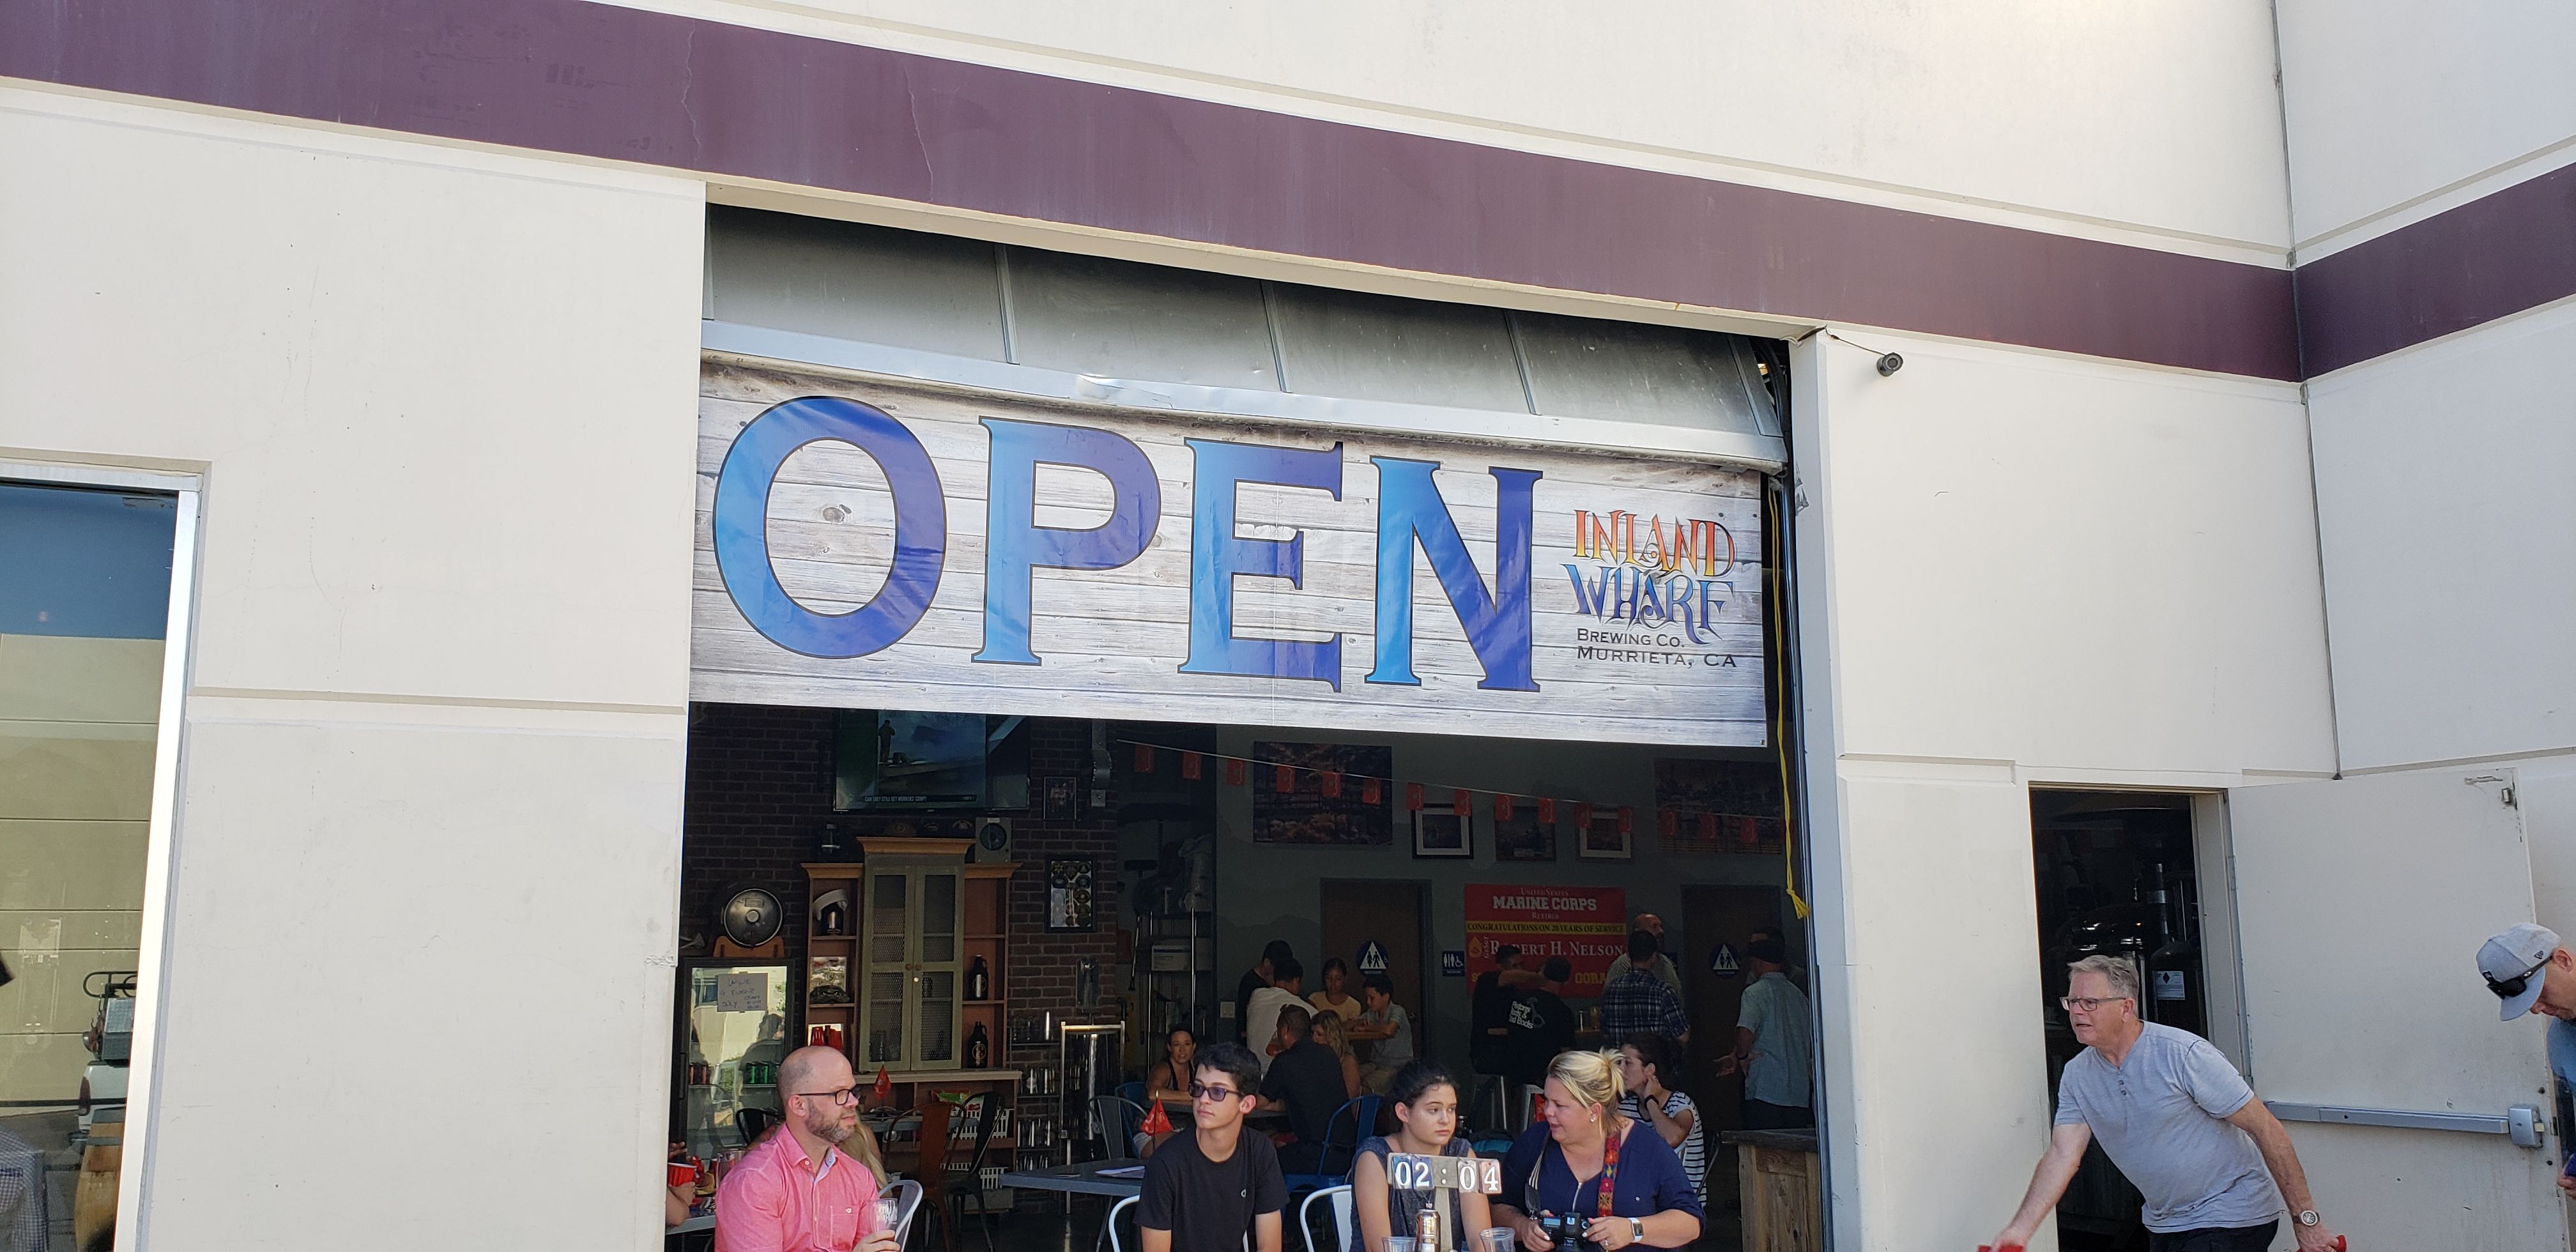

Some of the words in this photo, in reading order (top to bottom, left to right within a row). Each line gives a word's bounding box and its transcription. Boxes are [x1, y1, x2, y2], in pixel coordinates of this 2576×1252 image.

[712, 395, 1543, 692] OPEN
[1573, 509, 1735, 577] INLAND
[1560, 563, 1735, 646] WHARF
[1577, 628, 1651, 646] BREWING
[1577, 646, 1693, 669] MURRIETA,
[1703, 653, 1737, 668] CA
[1492, 896, 1549, 910] MARINE
[1551, 897, 1597, 912] CORPS
[1467, 923, 1538, 932] CONGRATULATIONS
[1559, 924, 1583, 933] YEARS
[1584, 924, 1593, 933] OF
[1595, 925, 1623, 933] SERVICE
[1489, 940, 1547, 956] RERT
[1549, 940, 1567, 956] H.
[1570, 941, 1623, 956] NELSON
[1574, 972, 1606, 984] OORA
